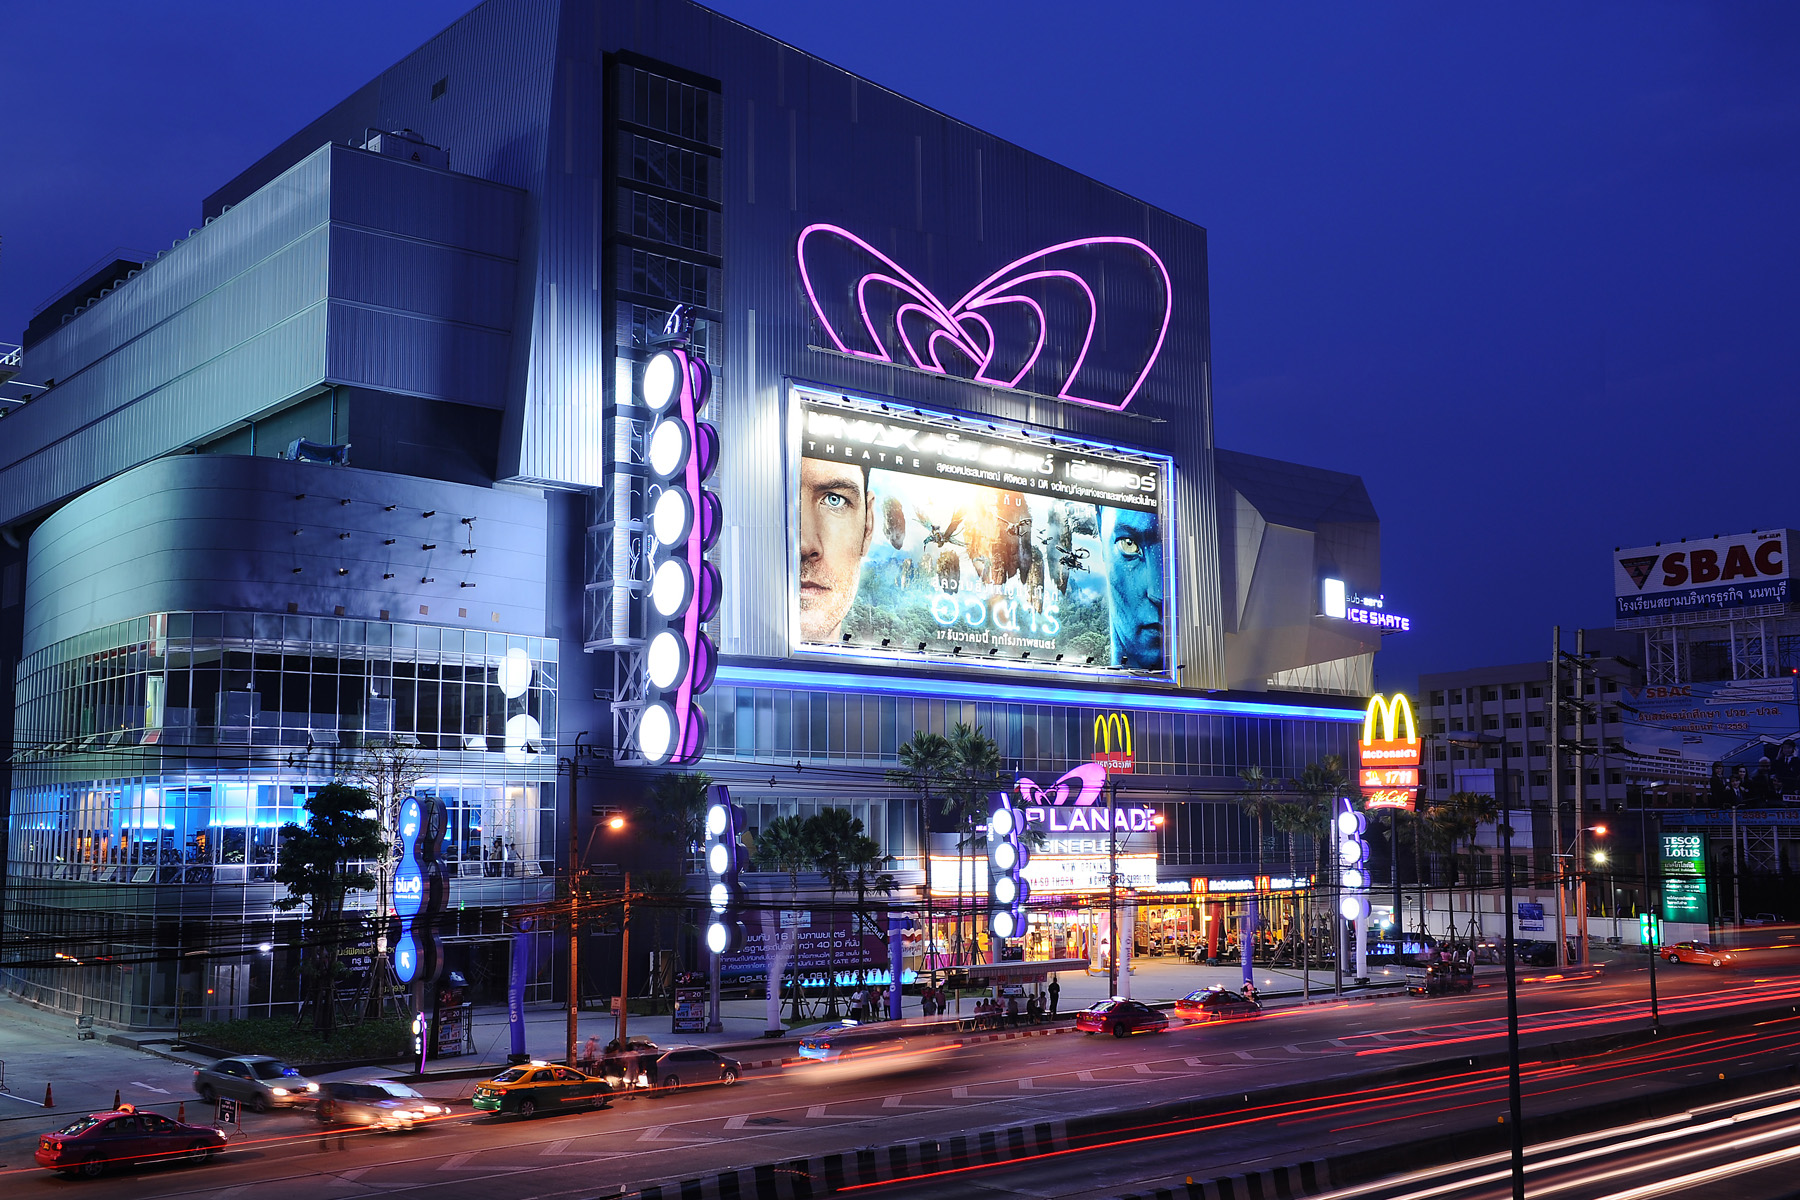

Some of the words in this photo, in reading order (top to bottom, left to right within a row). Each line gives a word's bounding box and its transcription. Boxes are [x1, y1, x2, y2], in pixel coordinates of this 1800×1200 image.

[808, 441, 920, 468] THEATRE
[1662, 541, 1783, 587] SBAC
[1347, 607, 1368, 624] ICE
[1369, 611, 1410, 631] SKATE
[937, 631, 945, 642] 17
[1646, 686, 1692, 698] SBAC
[1362, 749, 1417, 759] McDonald's
[1385, 771, 1412, 784] 1711
[1663, 836, 1701, 846] TESCO
[1666, 847, 1701, 858] Lotus
